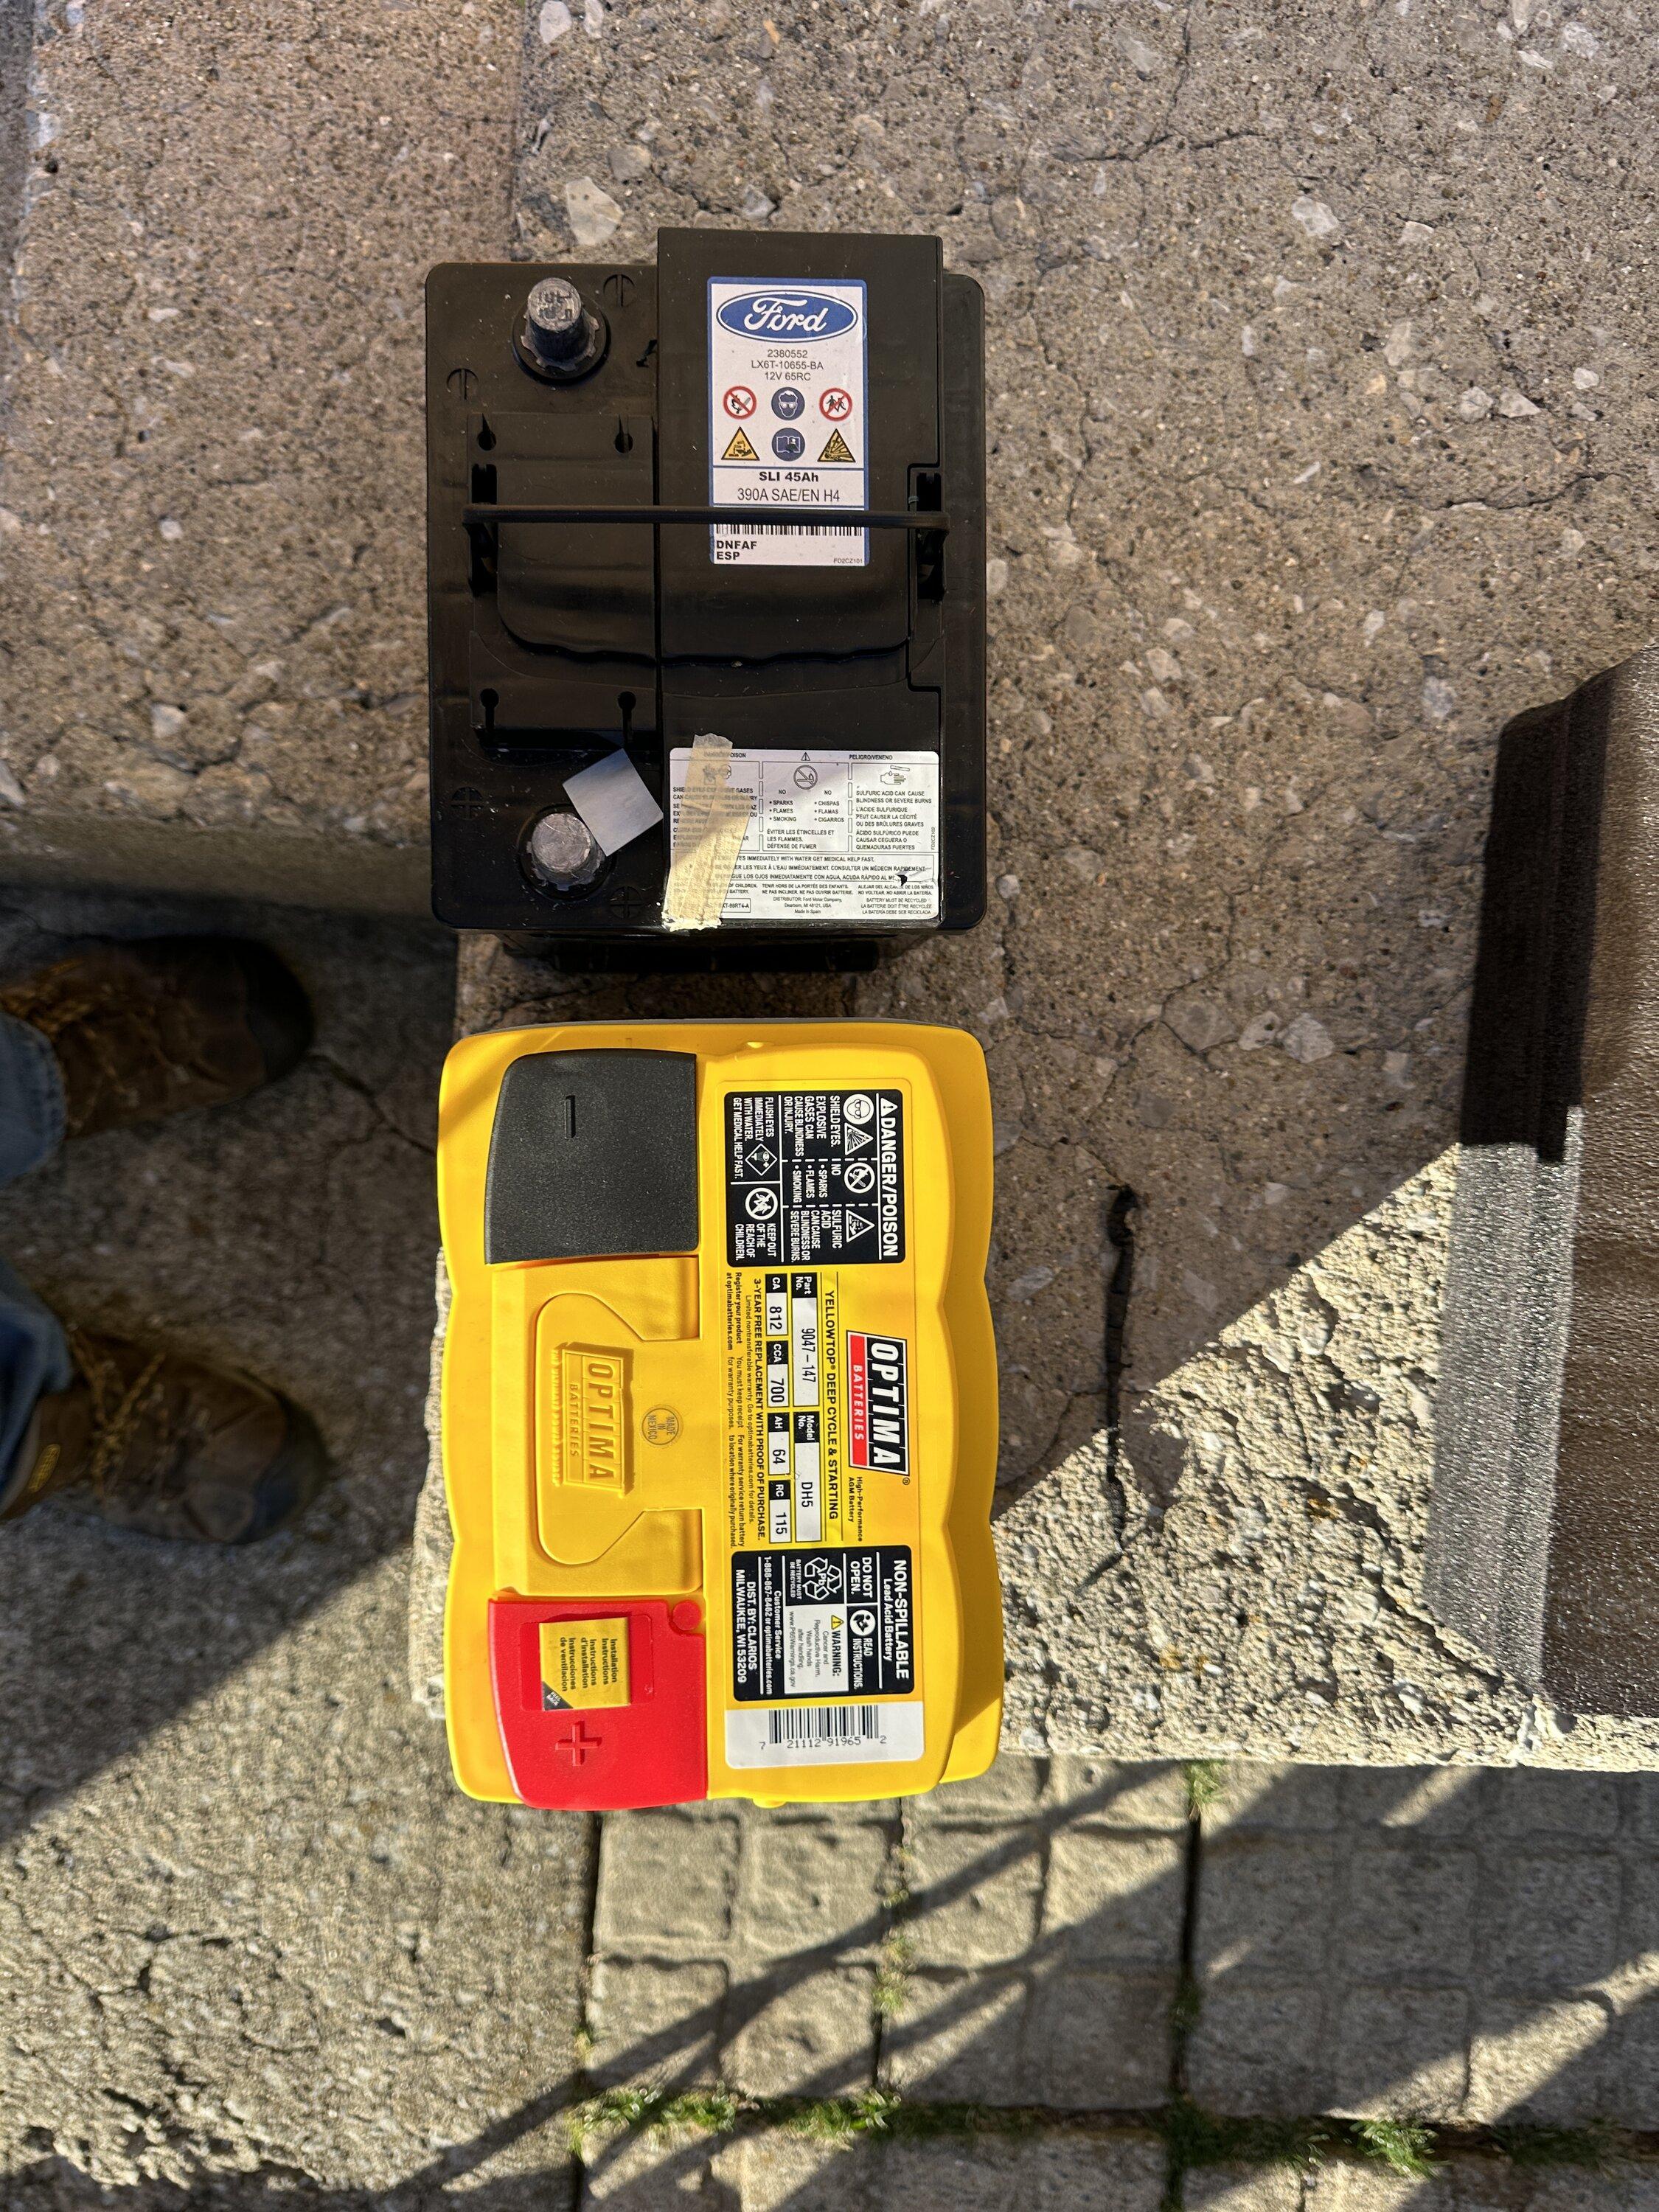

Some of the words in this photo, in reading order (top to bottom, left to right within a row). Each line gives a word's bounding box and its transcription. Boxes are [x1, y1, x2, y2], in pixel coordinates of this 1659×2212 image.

[744, 297, 828, 332] Ford
[751, 361, 824, 369] LX6T-10655-BA
[768, 349, 807, 358] 2380552
[765, 372, 782, 380] 12V
[785, 372, 810, 380] 65RC
[759, 472, 780, 481] SLI
[785, 472, 818, 482] 45Ah
[738, 488, 768, 501] 390A
[772, 489, 819, 501] SAE/EN
[824, 490, 840, 502] H4
[717, 540, 757, 549] DNFAF
[717, 552, 740, 560] ESP
[734, 1098, 742, 1111] GET
[744, 1098, 753, 1115] WITH
[765, 1097, 773, 1119] FLUSH
[785, 1096, 793, 1106] OR
[794, 1096, 803, 1119] CAUSE
[805, 1096, 814, 1122] GASES
[830, 1096, 841, 1123] SHIELD
[734, 1112, 742, 1141] MEDICAL
[745, 1116, 753, 1141] WATER.
[755, 1098, 764, 1141] IMMEDIATELY
[766, 1120, 774, 1137] EYES
[785, 1107, 793, 1133] INJURY.
[816, 1096, 827, 1138] EXPLOSIVE
[795, 1120, 804, 1156] BLINDNESS
[805, 1124, 814, 1138] CAN
[831, 1124, 841, 1147] EYES.
[734, 1142, 742, 1159] HELP
[734, 1160, 742, 1178] FAST.
[831, 1164, 841, 1175] NO
[793, 1171, 802, 1203] SMOKING
[806, 1170, 814, 1198] FLAMES
[818, 1170, 827, 1197] SPARKS
[881, 1118, 898, 1256] DANGER/POISON
[757, 1224, 765, 1233] OF
[790, 1211, 799, 1237] SEVERE
[811, 1211, 819, 1224] CAN
[821, 1210, 831, 1228] ACID
[832, 1210, 842, 1248] SULFURIC
[735, 1224, 744, 1260] CHILDREN.
[746, 1224, 754, 1247] REACH
[757, 1234, 765, 1248] THE
[768, 1223, 776, 1242] KEEP
[801, 1211, 810, 1250] BLINDNESS
[812, 1225, 820, 1248] CAUSE
[747, 1248, 754, 1257] OF
[768, 1243, 776, 1256] OUT
[791, 1238, 800, 1262] BURNS.
[801, 1251, 810, 1260] OR
[773, 1277, 780, 1290] CA
[770, 1307, 782, 1329] 812
[773, 1344, 782, 1362] CCA
[755, 1341, 763, 1410] REPLACEMENT
[771, 1379, 785, 1402] 700
[827, 1373, 835, 1404] DEEP
[853, 1365, 864, 1440] BATTERIES
[872, 1343, 900, 1463] OPTIMA
[570, 1384, 579, 1456] BATTERIES
[588, 1363, 613, 1479] OPTIMA
[647, 1416, 657, 1439] MEXICO
[667, 1417, 675, 1435] MADE
[775, 1416, 782, 1428] AH
[807, 1416, 815, 1440] Model
[828, 1408, 837, 1444] CYCLE
[773, 1450, 785, 1464] 64
[829, 1448, 836, 1456] &
[757, 1472, 764, 1484] OF
[829, 1460, 838, 1519] STARTING
[776, 1484, 783, 1497] RC
[801, 1482, 813, 1507] DH5
[776, 1512, 787, 1534] 115
[790, 1562, 796, 1571] BE
[862, 1557, 872, 1573] DO
[764, 1557, 772, 1616] 1-888-867-8462
[818, 1573, 827, 1585] Pb
[850, 1561, 860, 1594] OPEN.
[863, 1575, 872, 1597] NOT
[736, 1570, 745, 1632] MILWAUKEE,
[747, 1582, 756, 1606] DIST.
[884, 1579, 892, 1601] Lead
[748, 1609, 757, 1624] BY:
[884, 1603, 893, 1624] Acid
[894, 1560, 909, 1679] NON-SPILLABLE
[560, 1638, 567, 1646] de
[737, 1635, 745, 1647] WI
[748, 1626, 757, 1669] CLARIOS
[863, 1638, 872, 1656] READ
[883, 1626, 894, 1660] Battery
[568, 1638, 577, 1689] Instrucciones
[765, 1626, 773, 1694] optimabatteries.com
[832, 1631, 841, 1676] WARNING:
[853, 1638, 863, 1688] INSTRUCTIONS.
[560, 1649, 568, 1691] ventilacion
[737, 1649, 747, 1683] 53209
[759, 1742, 765, 1750] 7
[787, 1739, 821, 1749] 21112
[827, 1736, 861, 1746] 91965
[880, 1736, 887, 1744] 2
